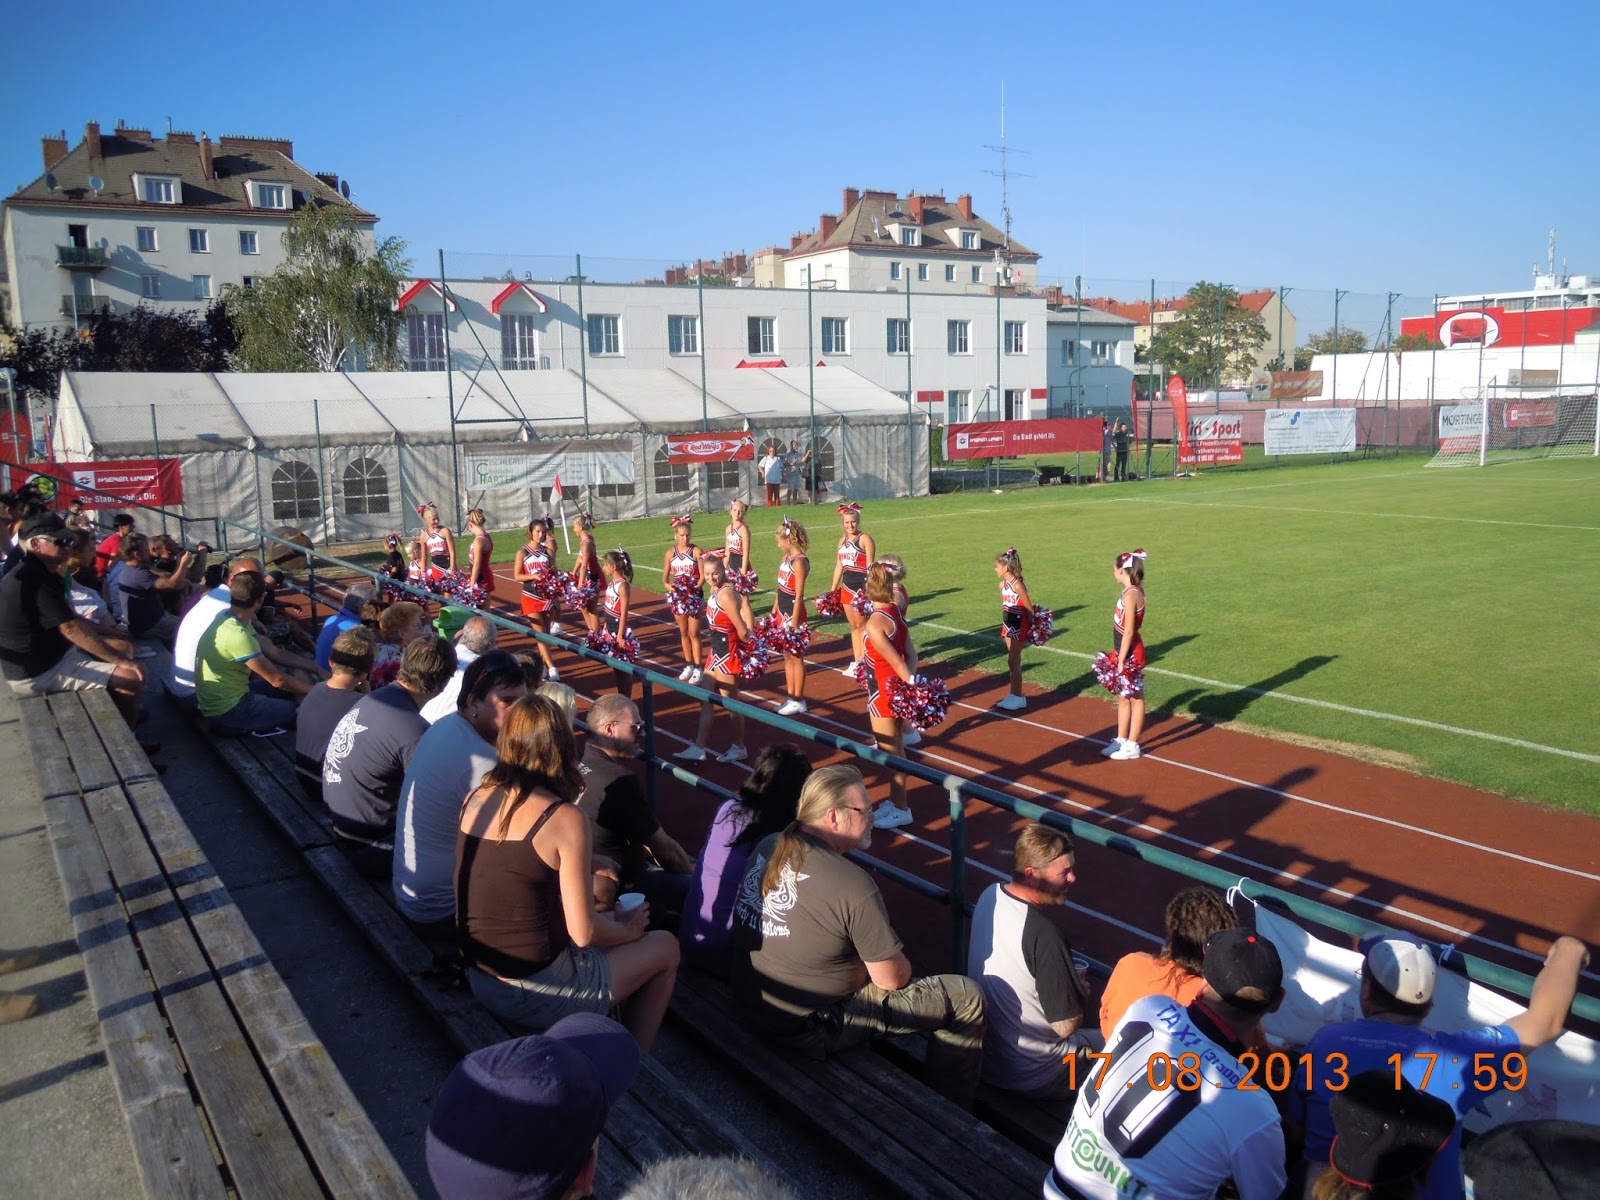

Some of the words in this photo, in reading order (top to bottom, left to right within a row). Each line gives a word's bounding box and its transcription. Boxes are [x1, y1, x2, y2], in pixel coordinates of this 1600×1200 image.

[1442, 413, 1484, 426] MORTINGE
[1212, 420, 1241, 438] Sport
[1013, 433, 1021, 441] Die
[701, 442, 720, 451] Wings
[130, 474, 155, 482] LINIEN
[80, 496, 92, 504] Die
[143, 493, 158, 501] Dir.
[671, 564, 694, 574] WINGS
[1156, 1004, 1202, 1047] TAXI
